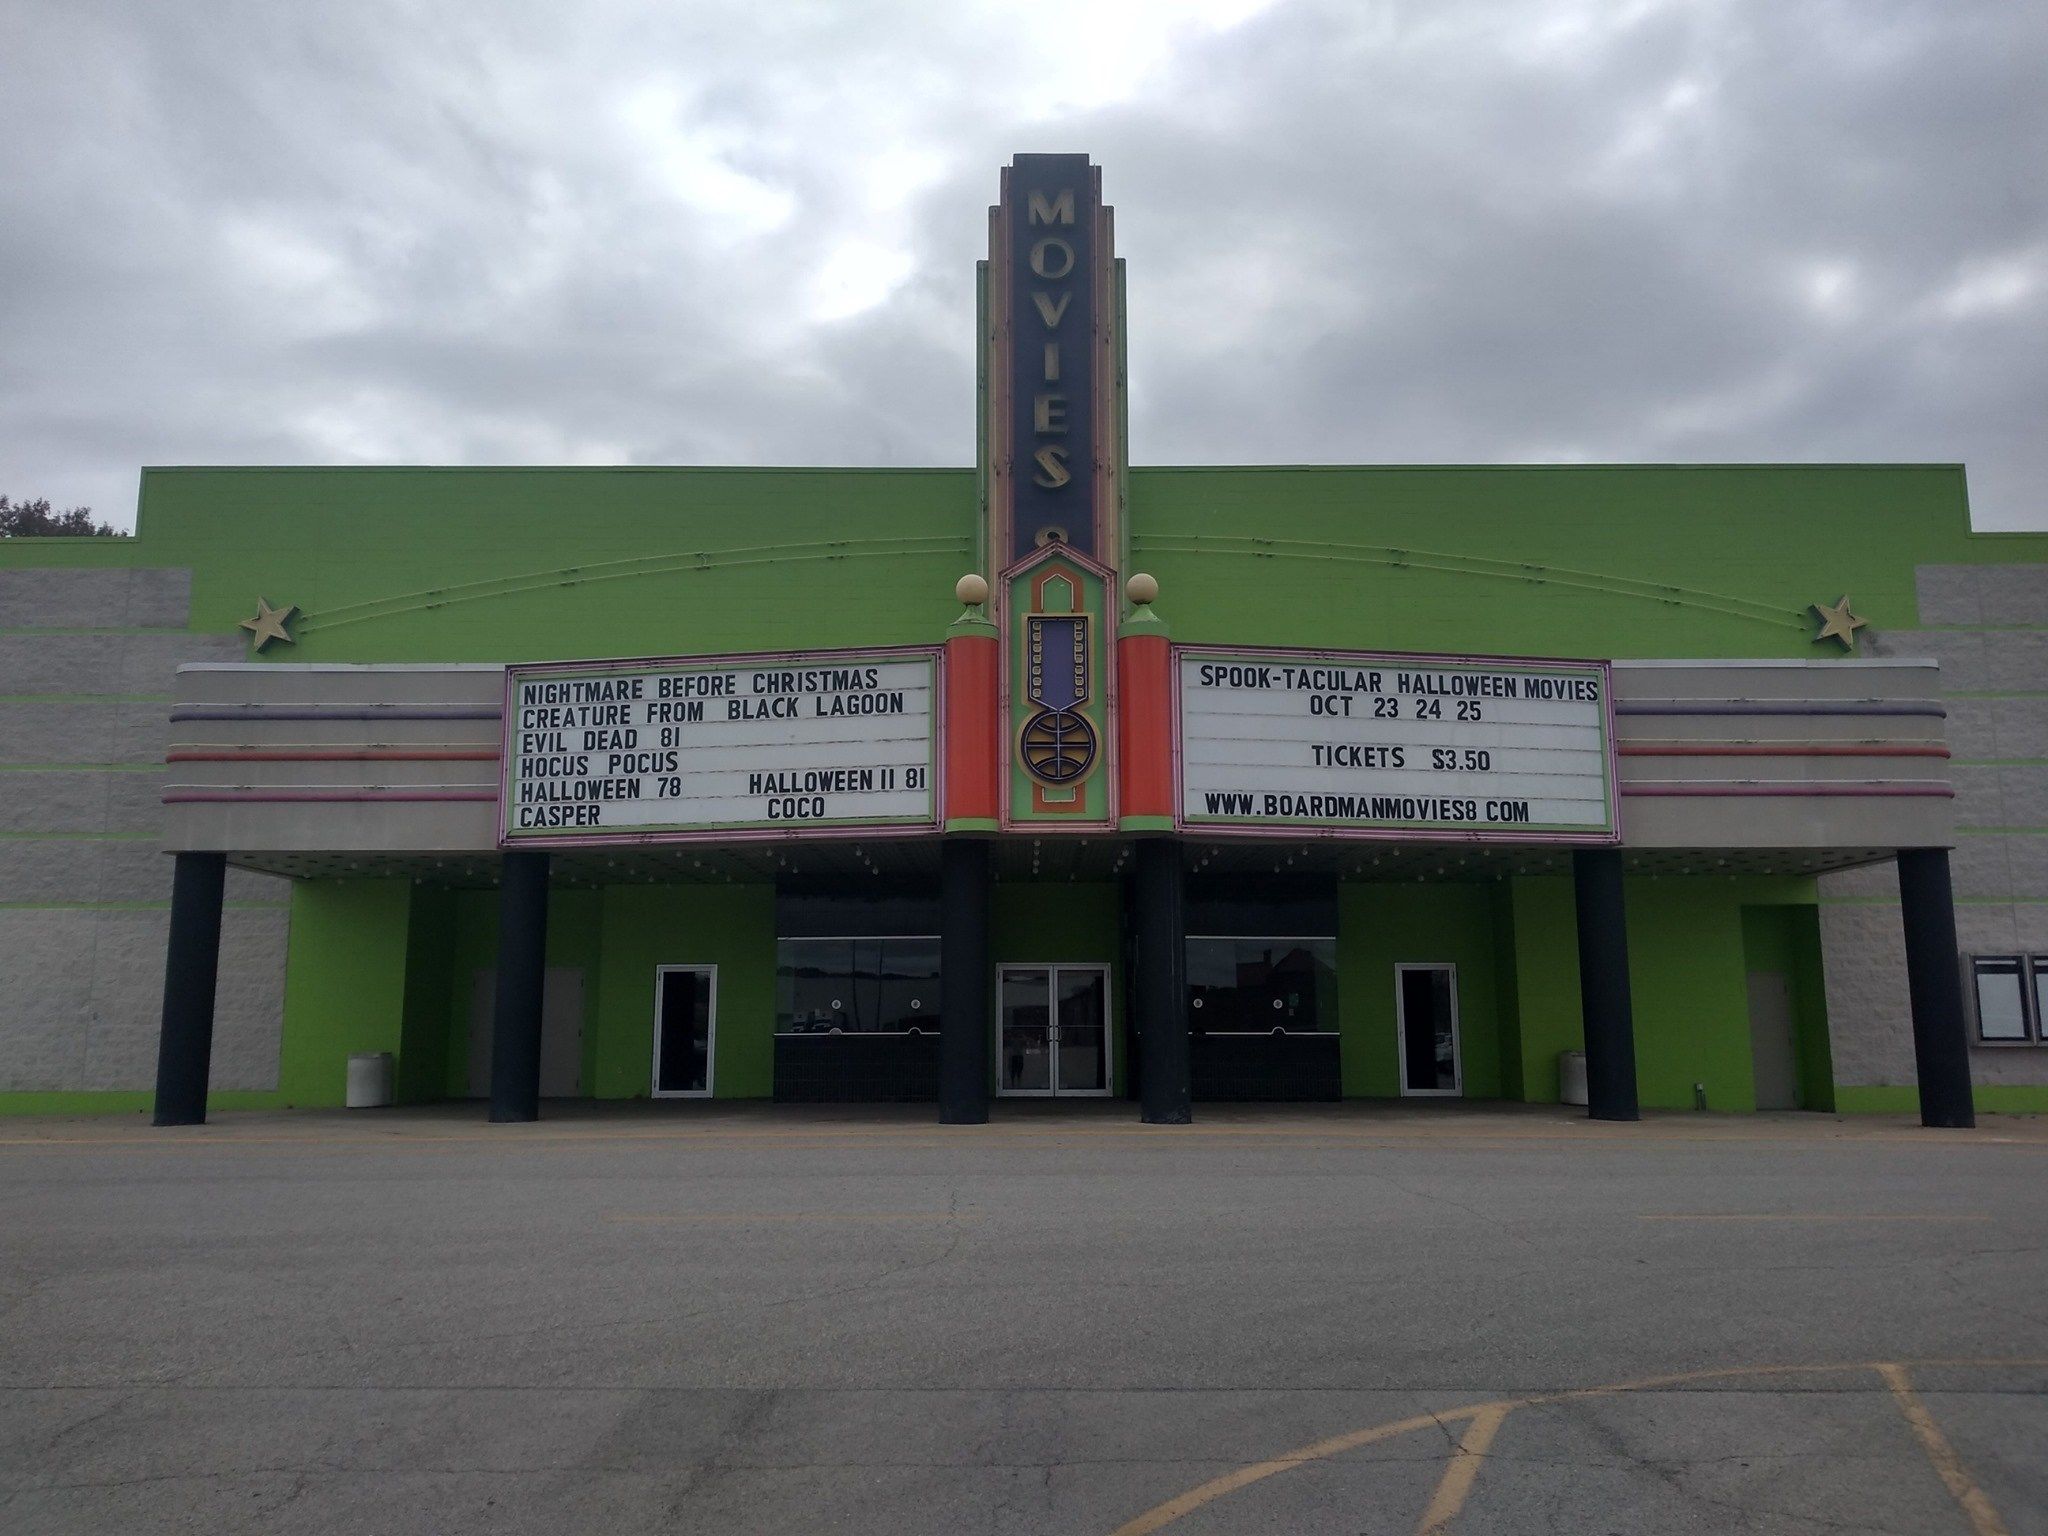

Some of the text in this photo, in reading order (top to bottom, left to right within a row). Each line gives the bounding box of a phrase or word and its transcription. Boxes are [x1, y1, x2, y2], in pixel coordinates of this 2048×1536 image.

[1027, 189, 1075, 488] MOVIES
[524, 669, 878, 705] NIGHTMARE BEFORE CHRISTMAS
[1200, 665, 1598, 701] SPOOK-TACULAR HALLOWEEN MOVIES
[524, 693, 904, 728] CREATURE FROM BLACK LAGOON
[1311, 695, 1481, 720] OCT 23 24 25
[523, 728, 679, 753] EVIL DEAD 81
[522, 752, 678, 777] HOCUS POCUS
[1312, 745, 1404, 767] TICKETS
[521, 777, 681, 802] HALLOWEEN 78
[750, 769, 872, 794] HALLOWEEN
[906, 768, 925, 788] 81
[520, 805, 600, 827] CASPER
[768, 798, 825, 819] COCO
